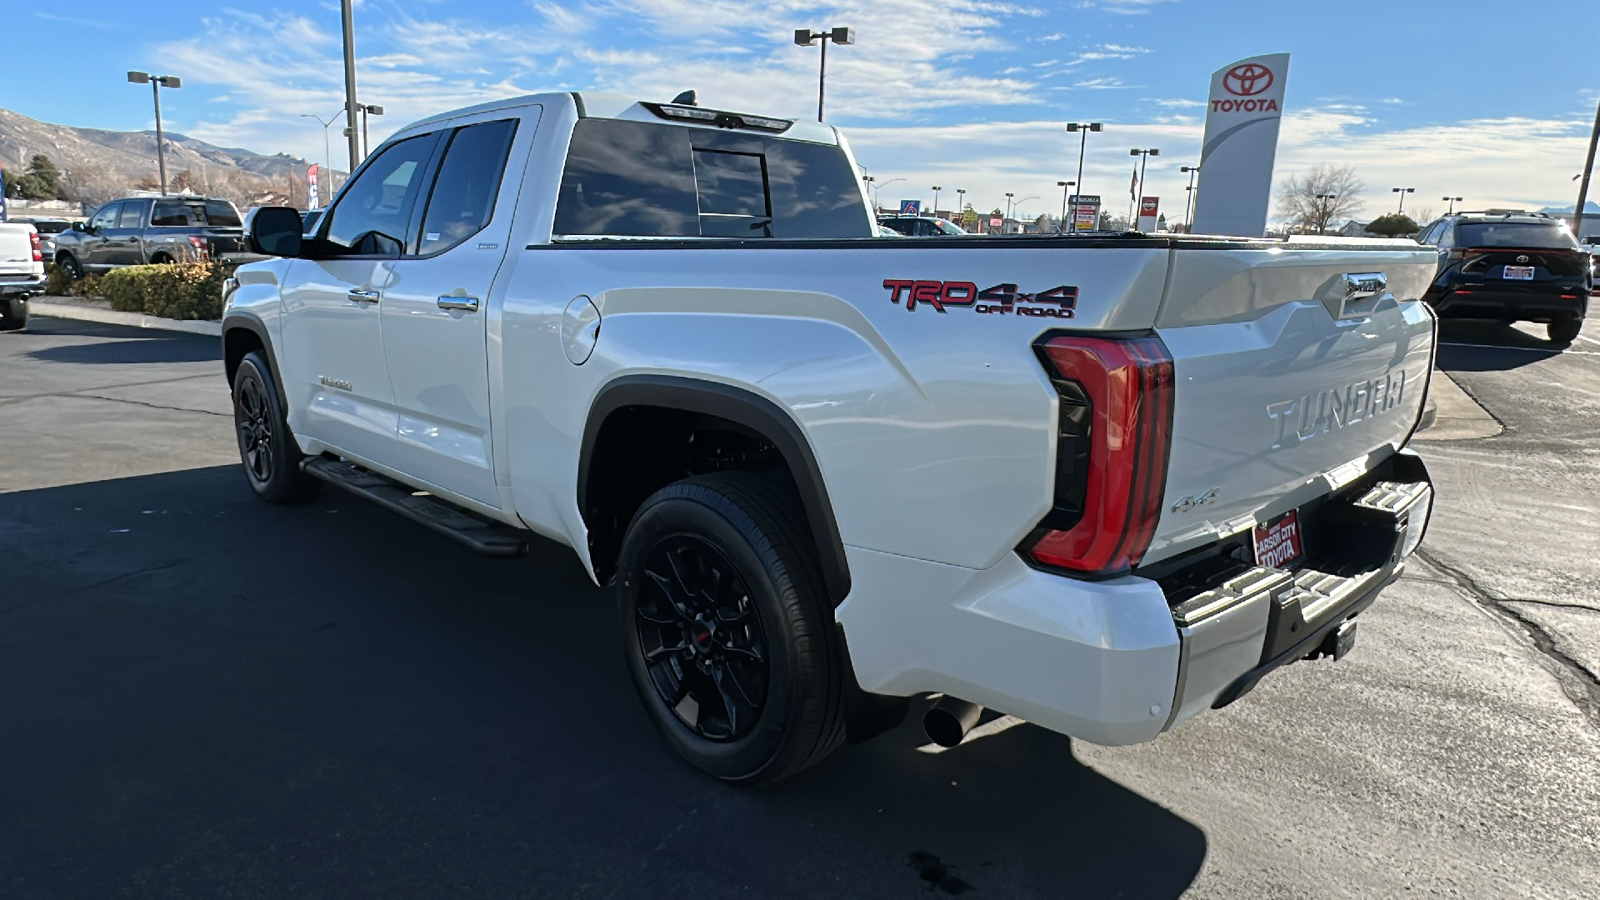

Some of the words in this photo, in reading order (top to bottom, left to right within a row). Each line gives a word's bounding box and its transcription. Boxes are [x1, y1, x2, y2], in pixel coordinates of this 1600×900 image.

[1211, 99, 1278, 113] TOYOTA
[883, 279, 978, 314] TRD
[975, 304, 1014, 315] OFF
[1016, 306, 1075, 319] ROAD
[1266, 368, 1405, 449] TUNDRA
[1281, 522, 1296, 539] CITY
[1260, 538, 1295, 569] TOYOTA
